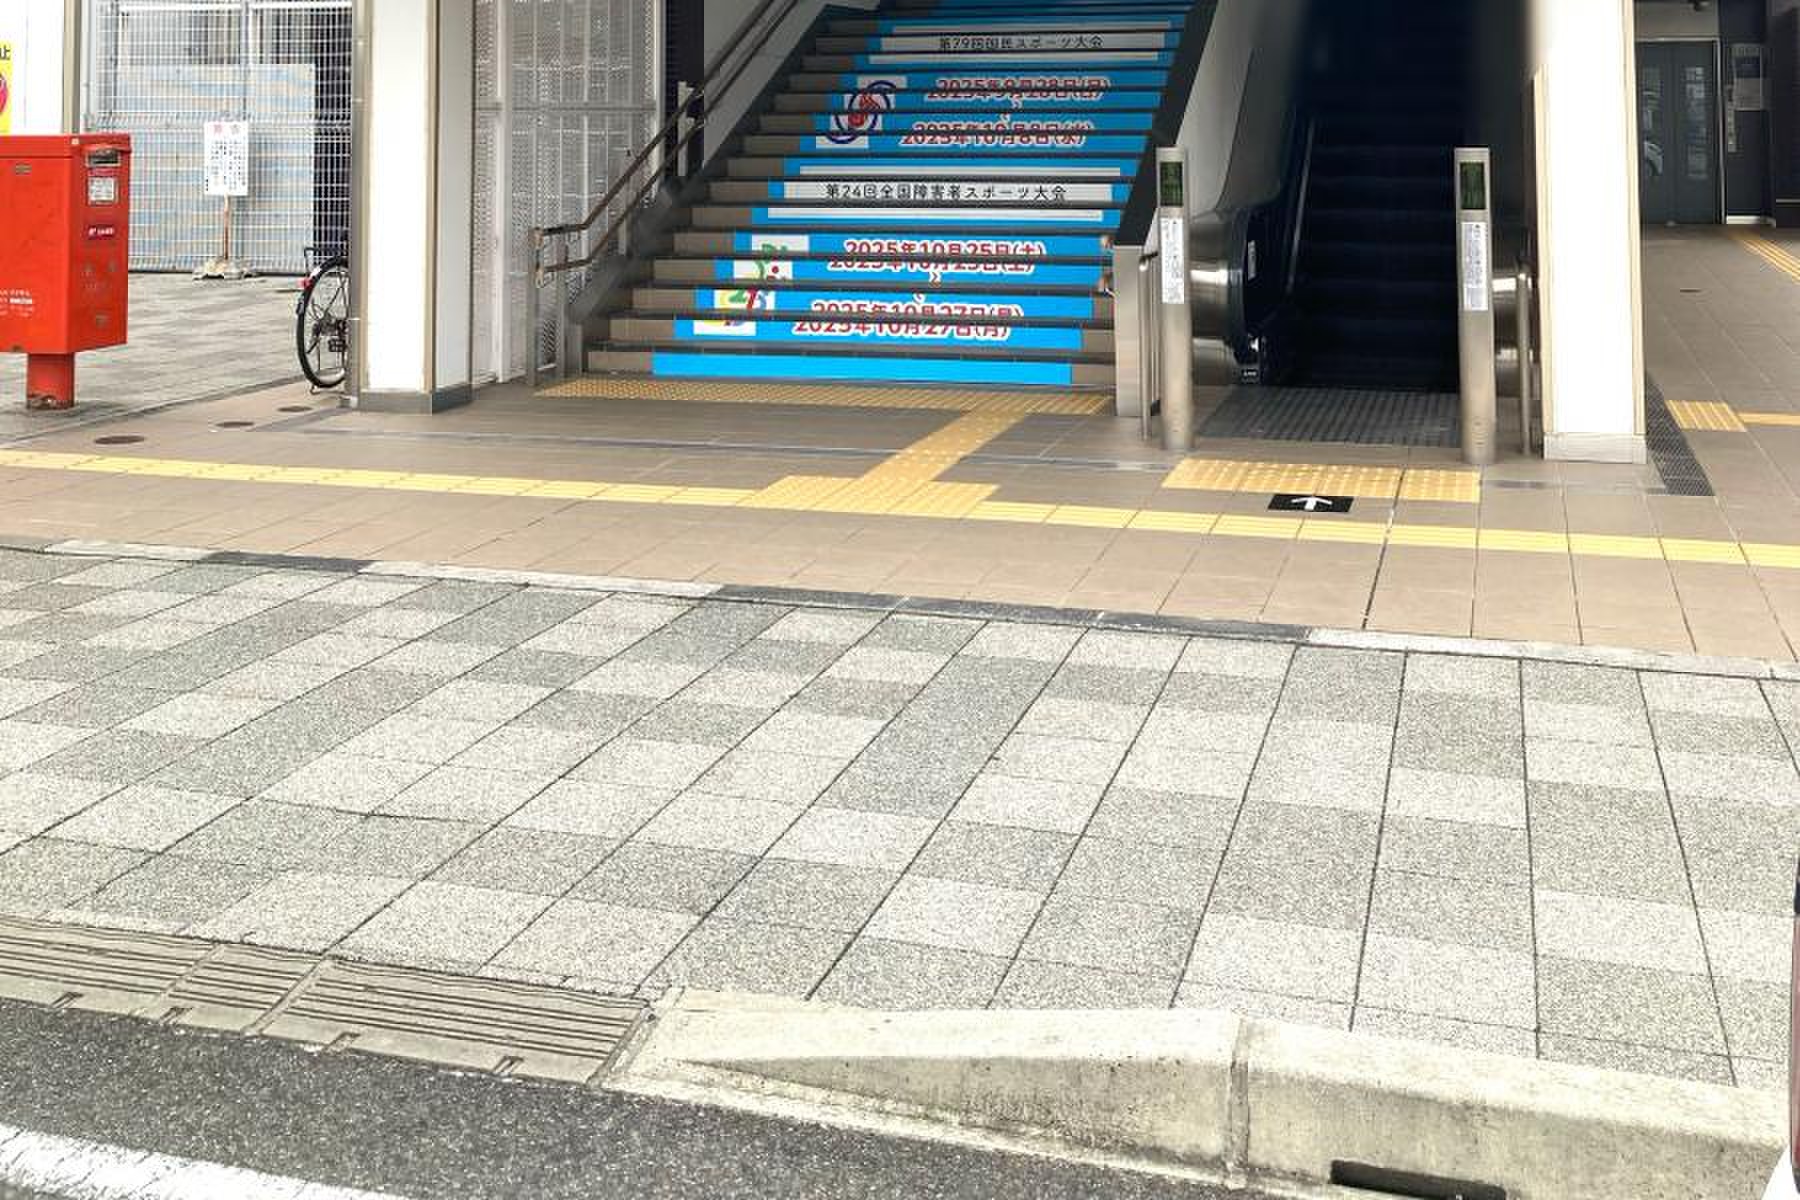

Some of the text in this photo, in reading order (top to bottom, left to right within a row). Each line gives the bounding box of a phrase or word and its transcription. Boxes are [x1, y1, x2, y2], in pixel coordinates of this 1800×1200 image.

[826, 184, 1067, 200] 第24回全国障害者スポーツ大会
